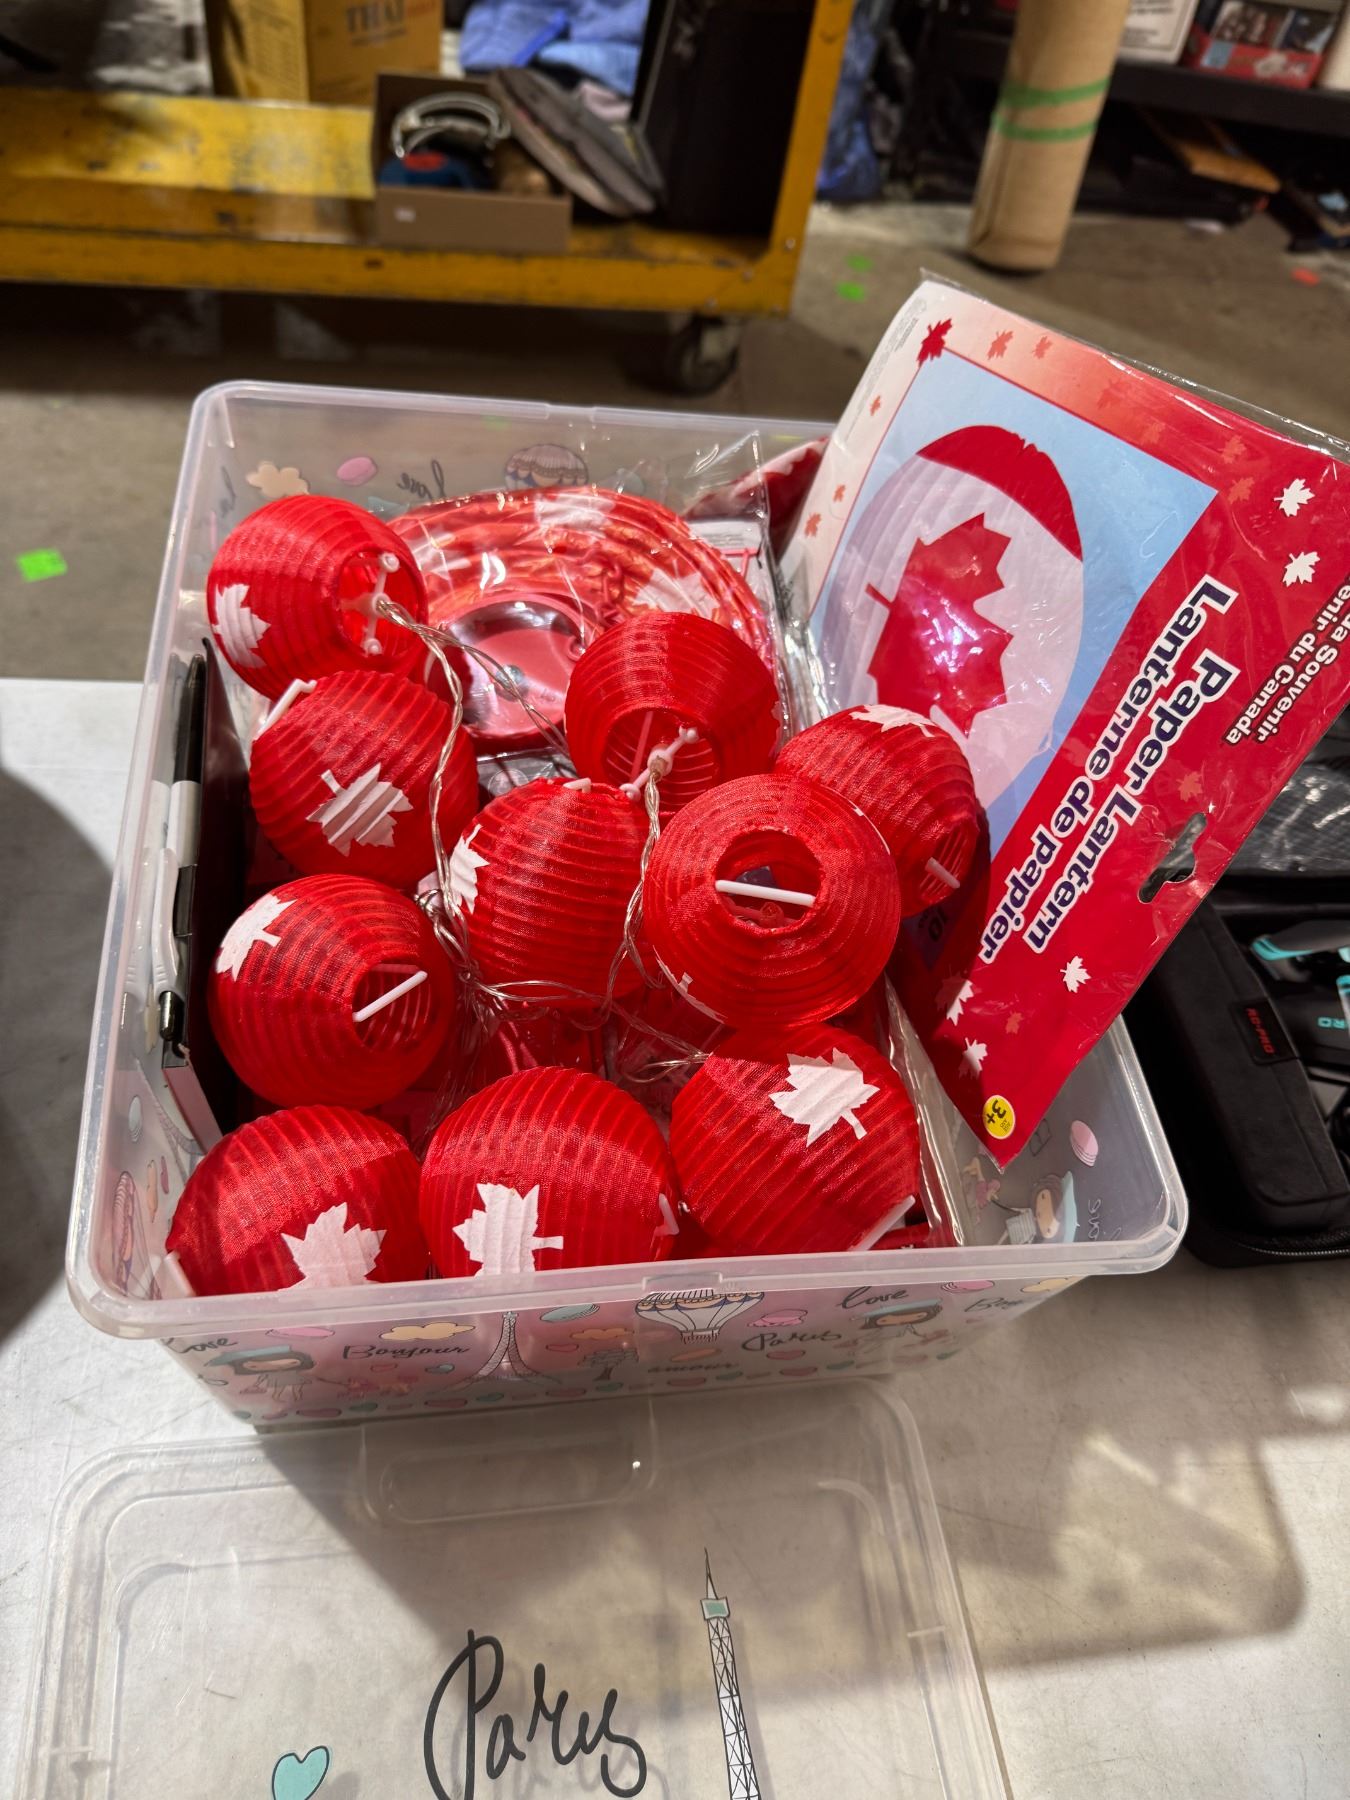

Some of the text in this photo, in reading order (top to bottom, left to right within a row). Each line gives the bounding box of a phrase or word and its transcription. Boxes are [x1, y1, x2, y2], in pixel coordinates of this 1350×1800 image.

[1289, 632, 1316, 663] du
[1226, 664, 1295, 744] Canada
[1256, 644, 1338, 742] Souvenir
[979, 575, 1238, 963] Lanterne de papier
[1023, 649, 1240, 953] Paper Lantern
[986, 1099, 1007, 1124] 3+
[343, 1343, 470, 1360] Bonjour
